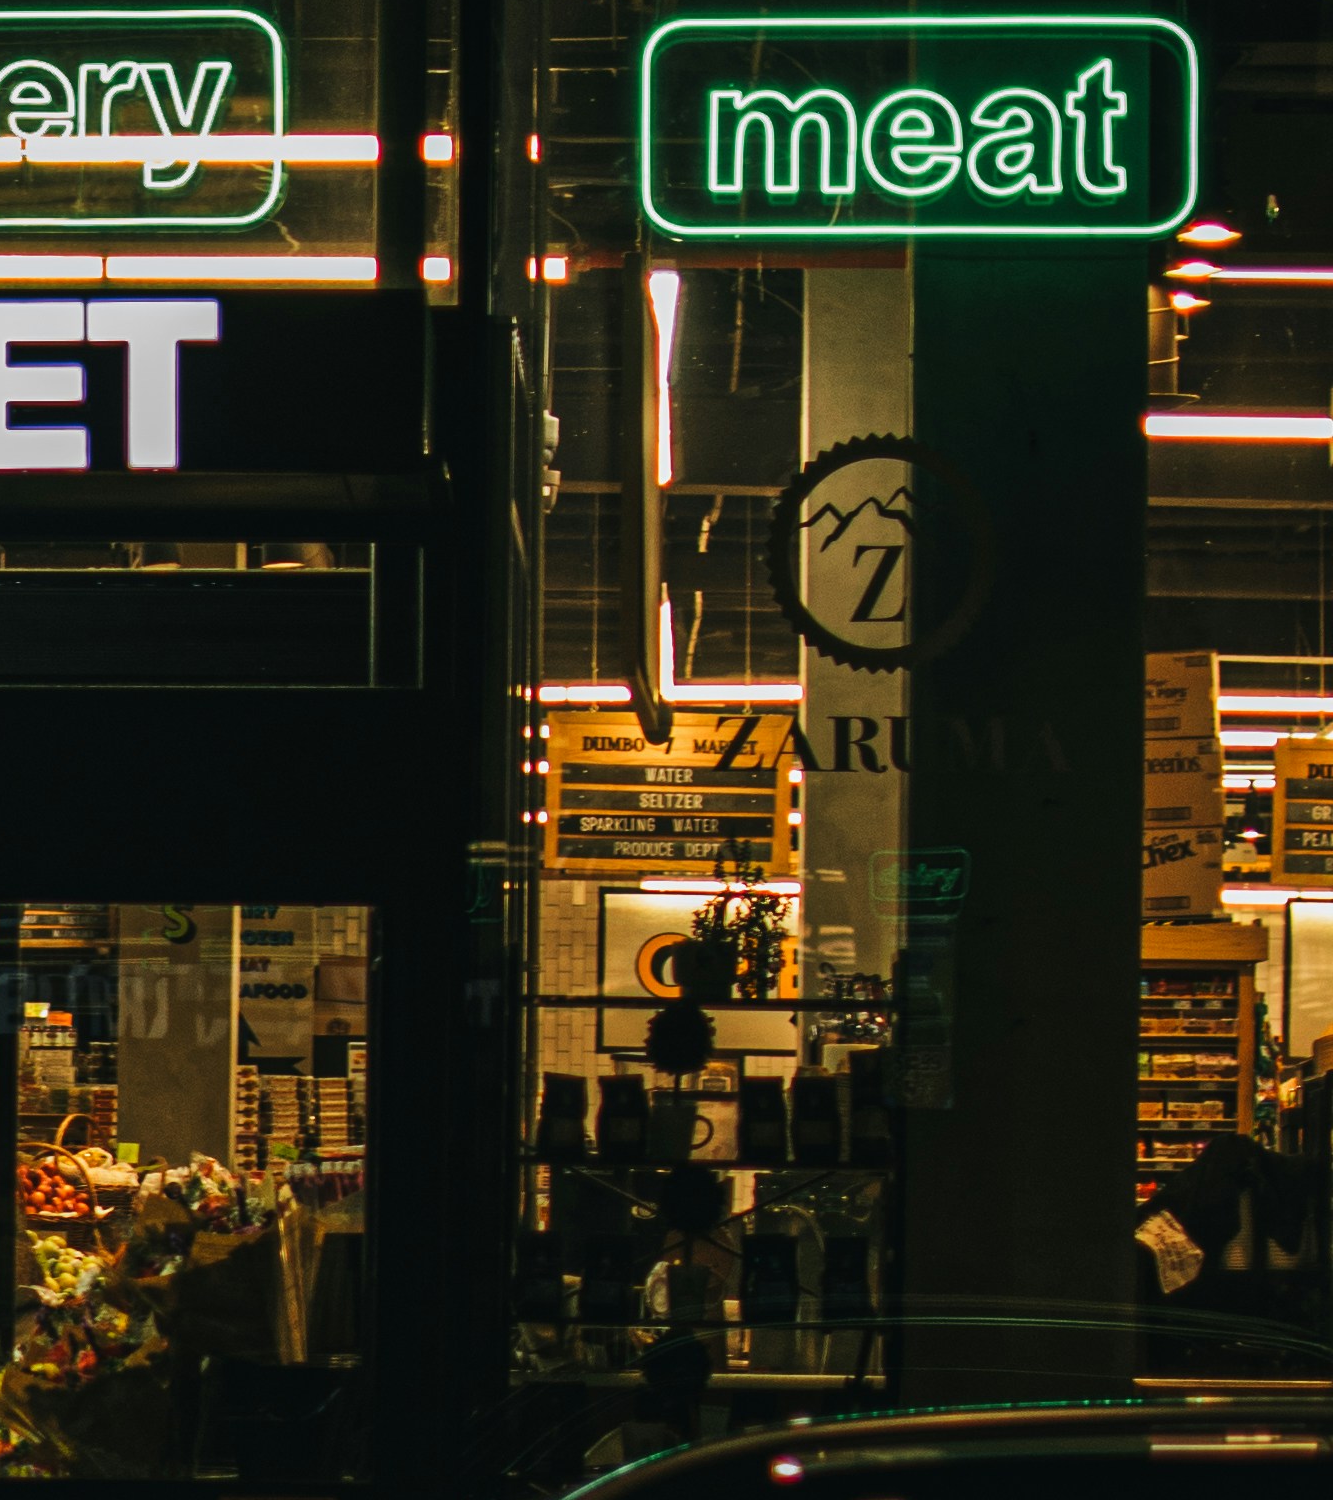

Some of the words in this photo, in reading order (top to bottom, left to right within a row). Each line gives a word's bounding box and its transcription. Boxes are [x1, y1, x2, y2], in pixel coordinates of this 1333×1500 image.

[708, 56, 1129, 197] meat
[715, 715, 1072, 773] ZARUMA
[644, 768, 694, 783] WATER
[639, 793, 703, 809] SELTZER
[579, 817, 657, 832] SPARKLING
[672, 818, 720, 832] WATER
[613, 841, 675, 857] PRODUCE
